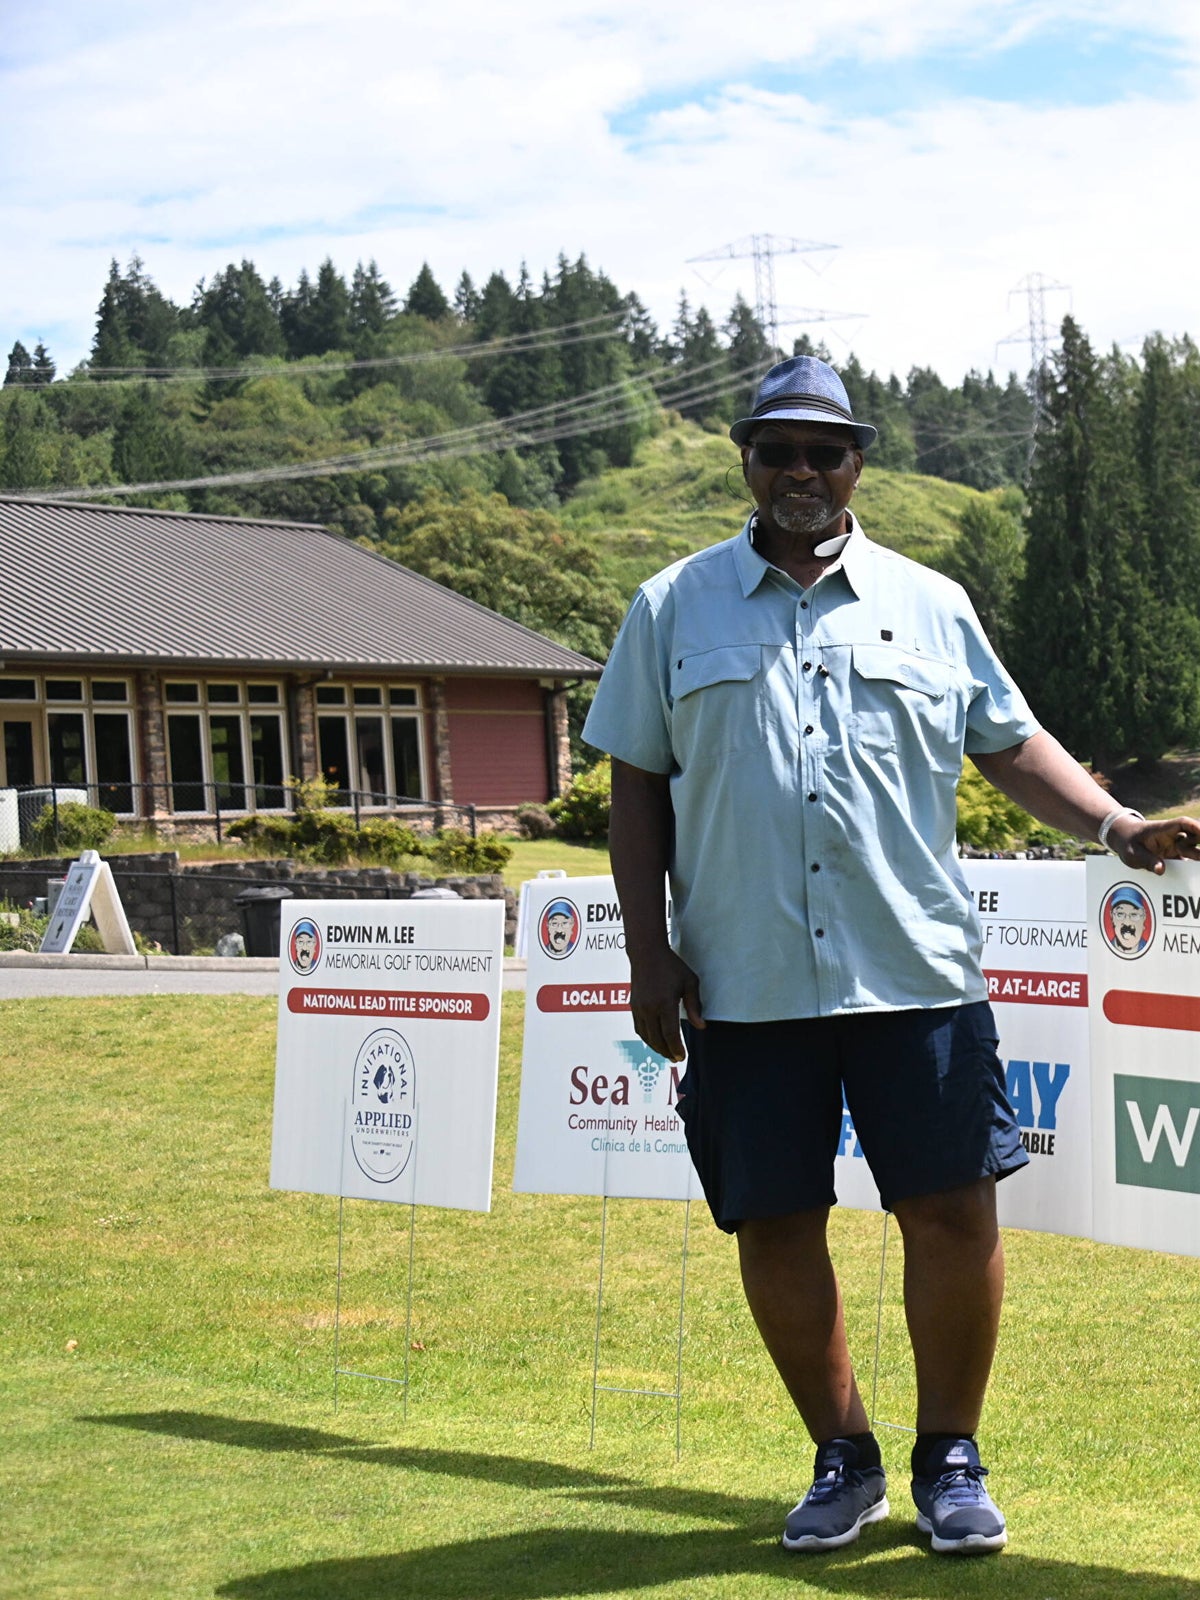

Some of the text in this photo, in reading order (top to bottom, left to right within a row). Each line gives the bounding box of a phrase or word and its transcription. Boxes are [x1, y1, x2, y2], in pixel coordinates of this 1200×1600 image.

[970, 891, 998, 912] EE
[327, 925, 414, 944] EDWIN M. LEE
[326, 954, 492, 972] MEMORIAL GOLF TOURNAMENT
[563, 989, 606, 1006] LOCAL
[1001, 978, 1080, 998] AT-LARGE
[303, 994, 472, 1014] NATIONAL LEAD TITLE SPONSOR
[361, 1044, 407, 1100] INVITATIONAL
[569, 1066, 629, 1105] Sea
[354, 1111, 412, 1129] APPLIED
[568, 1113, 679, 1135] Community Health
[356, 1127, 409, 1137] UNDERWRITERS
[629, 1138, 640, 1152] de
[643, 1139, 651, 1152] la
[1020, 1131, 1055, 1155] ABLE
